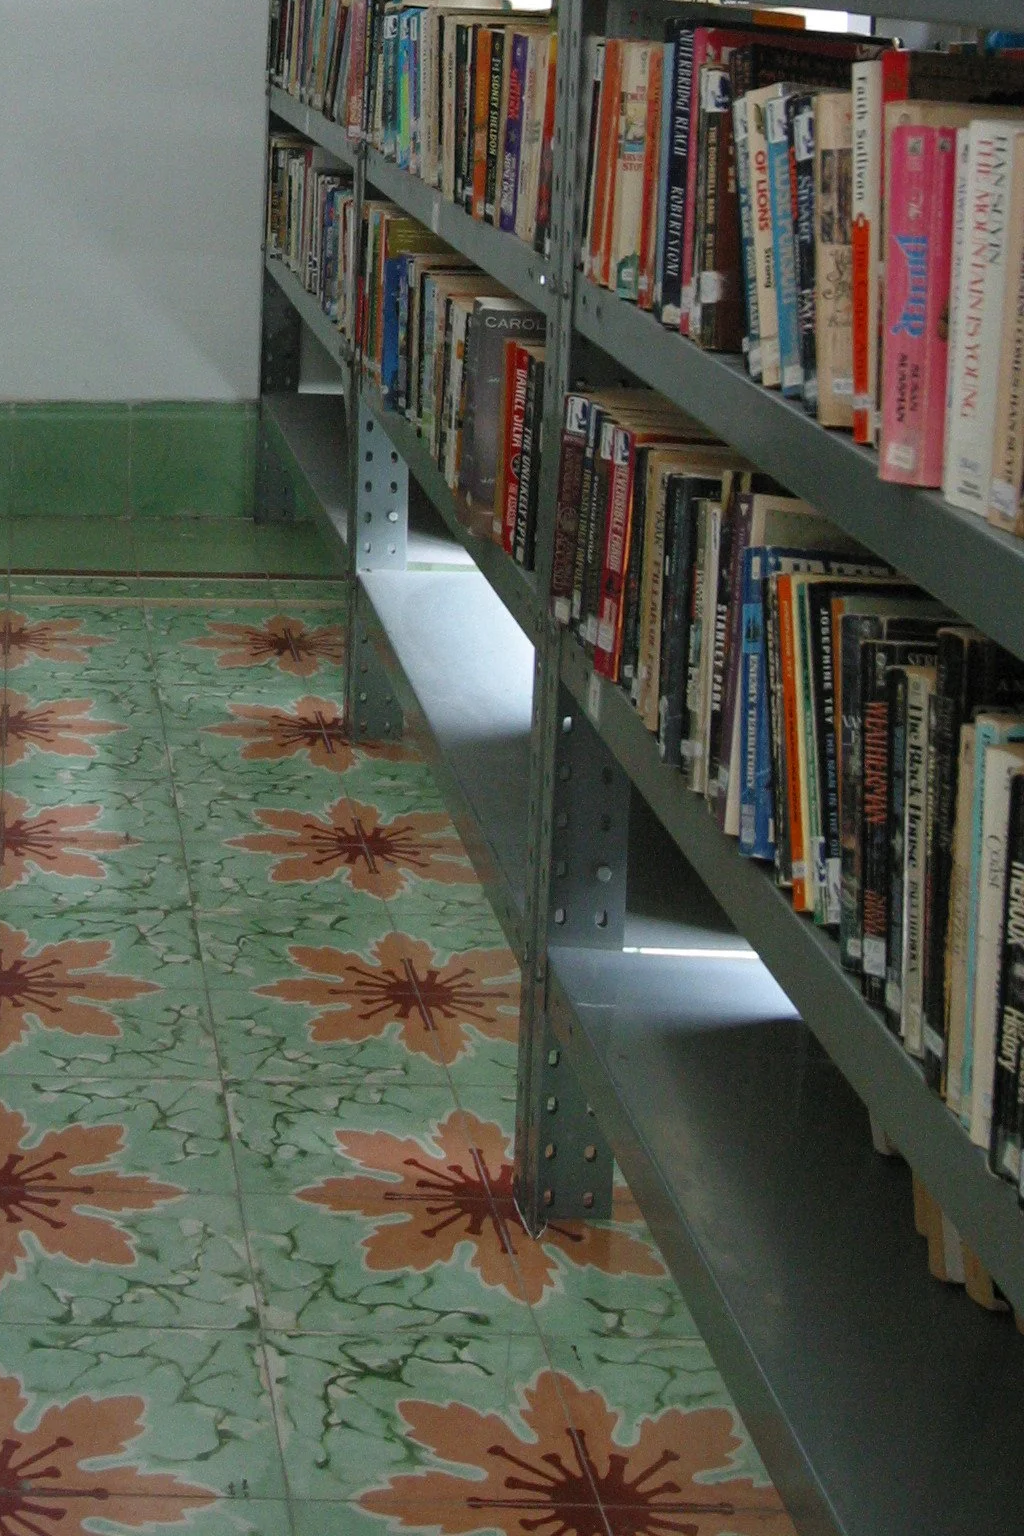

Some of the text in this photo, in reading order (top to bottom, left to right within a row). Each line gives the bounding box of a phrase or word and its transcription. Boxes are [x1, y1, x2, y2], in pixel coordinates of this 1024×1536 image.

[675, 29, 693, 111] OUTERBRIDGE
[854, 76, 869, 119] Faith
[489, 74, 500, 155] SIDNEY SHELDON
[673, 115, 689, 157] REACH
[707, 126, 717, 144] THE
[707, 146, 717, 196] DOORBELL
[854, 128, 870, 202] Sullivan
[987, 136, 1008, 265] HAN SUYIN
[755, 150, 775, 289] OF LIONS Strong
[960, 137, 994, 419] THE MOUNTAIN IS YOUNG
[511, 368, 527, 449] DANIEL SILVA
[515, 427, 533, 545] THE UNLIKELY SPY
[711, 603, 728, 712] STANLEY PARK
[819, 608, 832, 692] JOSEPHINE
[746, 654, 758, 790] ENEMY TERRITORY
[823, 696, 834, 725] TEY
[824, 732, 835, 756] THE
[825, 759, 836, 791] MAN
[828, 796, 837, 809] IN
[863, 702, 889, 824] WEATHERMAN
[828, 811, 839, 834] THE
[906, 702, 922, 973] The Black House PAUL THEROUX
[987, 835, 1003, 889] Coast
[1006, 860, 1024, 947] THEROUX
[999, 1005, 1021, 1073] History
